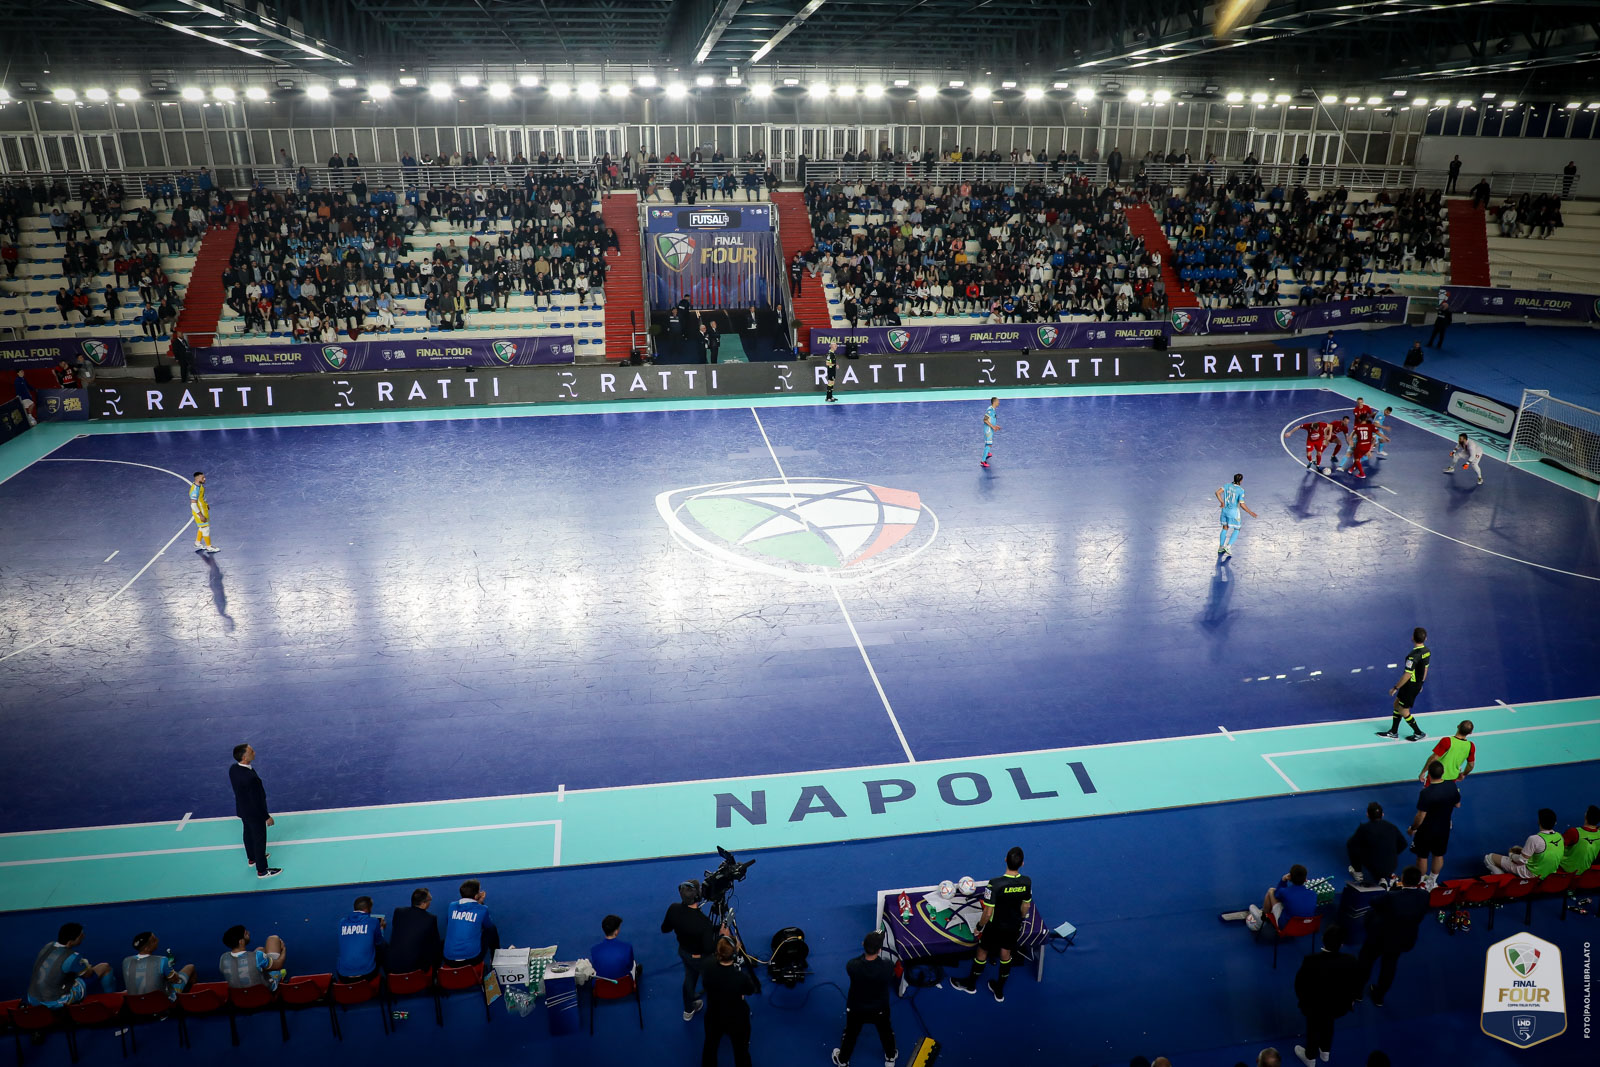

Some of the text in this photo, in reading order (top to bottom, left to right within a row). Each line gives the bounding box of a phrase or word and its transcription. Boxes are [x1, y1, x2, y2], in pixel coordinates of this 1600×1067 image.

[692, 215, 724, 225] FUTSAL
[714, 237, 744, 246] FINAL
[700, 247, 758, 264] FOUR
[1513, 297, 1541, 306] FINAL
[1543, 299, 1573, 309] FOUR
[1212, 314, 1259, 324] FINAL FOUR
[969, 332, 994, 341] FINAL
[995, 331, 1020, 340] FOUR
[1115, 329, 1137, 338] FINAL
[1138, 328, 1162, 337] FOUR
[817, 335, 869, 345] FINAL FOUR
[30, 347, 61, 358] FOUR
[244, 353, 273, 363] FINAL
[273, 352, 302, 361] FOUR
[416, 348, 444, 357] FINAL
[445, 347, 473, 356] FOUR
[1016, 357, 1120, 379] RATTI
[1204, 352, 1301, 374] RATTI
[814, 362, 925, 385] RATTI
[600, 370, 718, 393] RATTI
[377, 377, 499, 401] RATTI
[146, 386, 273, 411] RATTI
[713, 761, 1098, 829] NAPOLI
[1004, 885, 1026, 894] LEGEA
[452, 910, 478, 923] NAPOLI
[341, 924, 368, 936] NAPOLI
[499, 973, 525, 983] TOP
